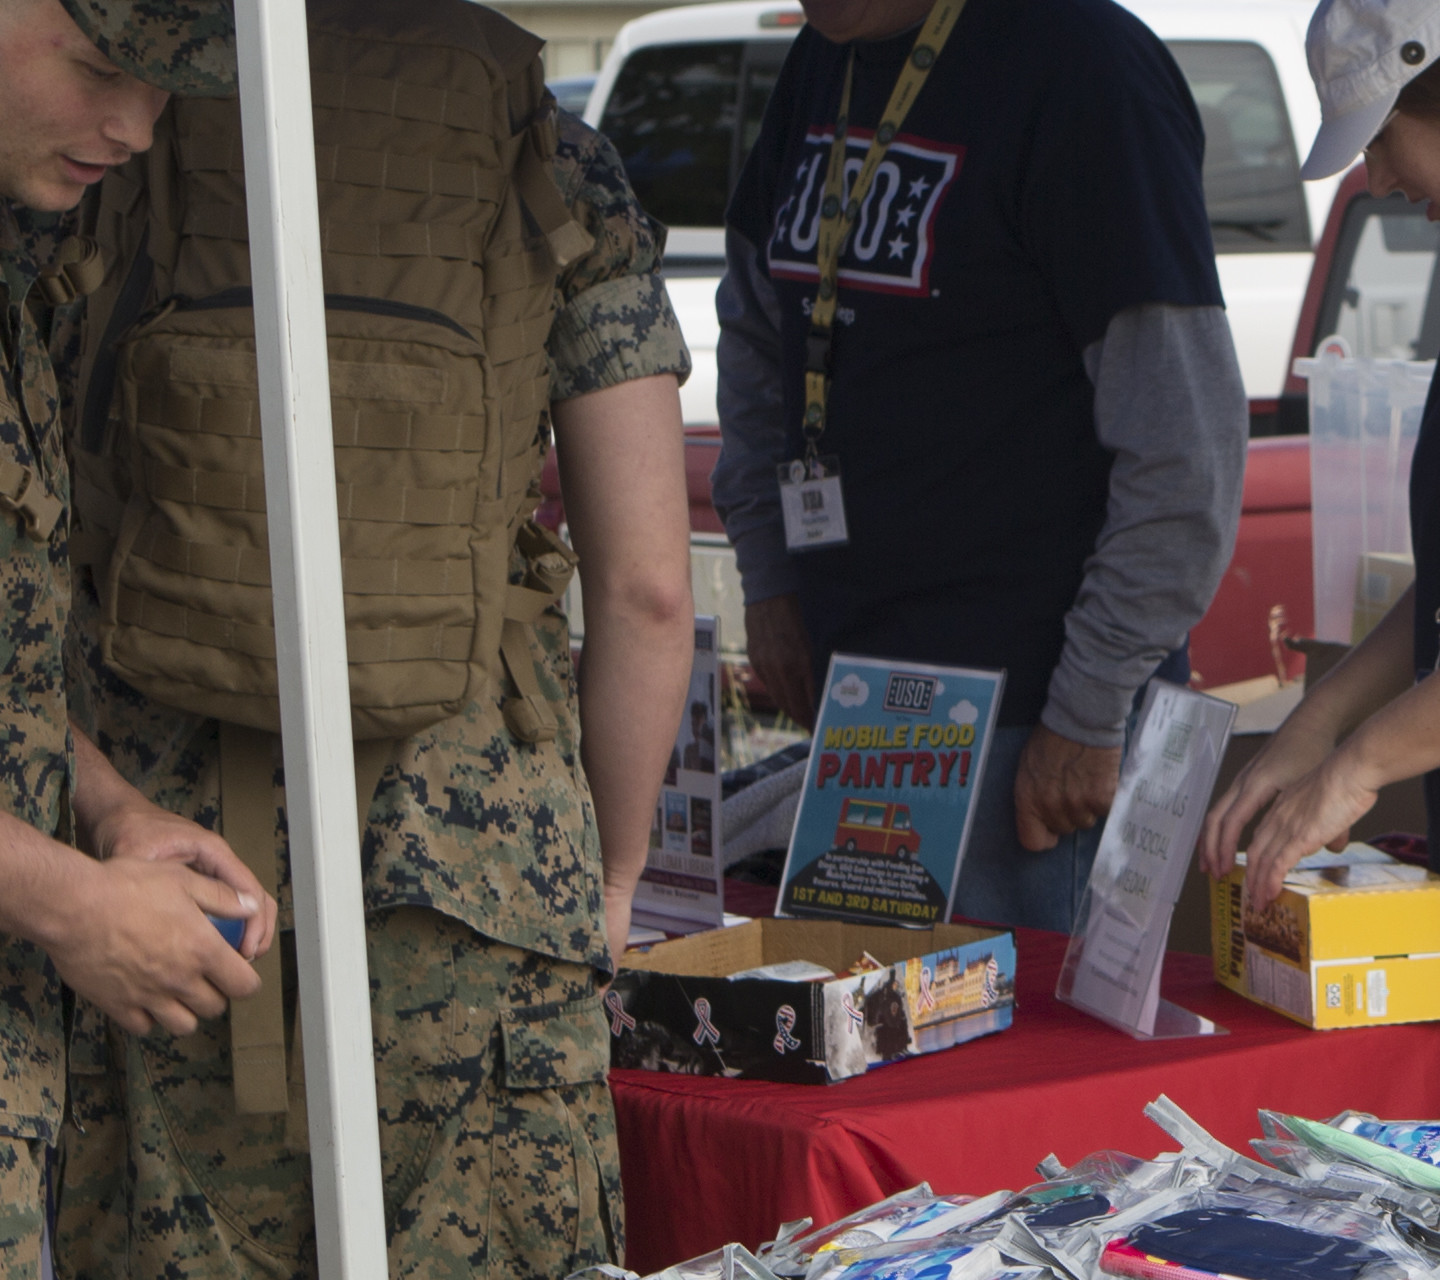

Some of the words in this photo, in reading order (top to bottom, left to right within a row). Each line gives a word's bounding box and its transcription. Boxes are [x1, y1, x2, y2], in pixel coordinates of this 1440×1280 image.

[895, 679, 925, 708] USO
[824, 725, 908, 749] MOBILE
[913, 724, 975, 748] FOOD
[816, 751, 971, 788] PANTRY!
[793, 886, 816, 903] 1ST
[817, 890, 843, 907] AND
[845, 894, 869, 911] 3RD
[871, 898, 939, 919] SATURDAY
[1229, 883, 1246, 978] PROTEIN
